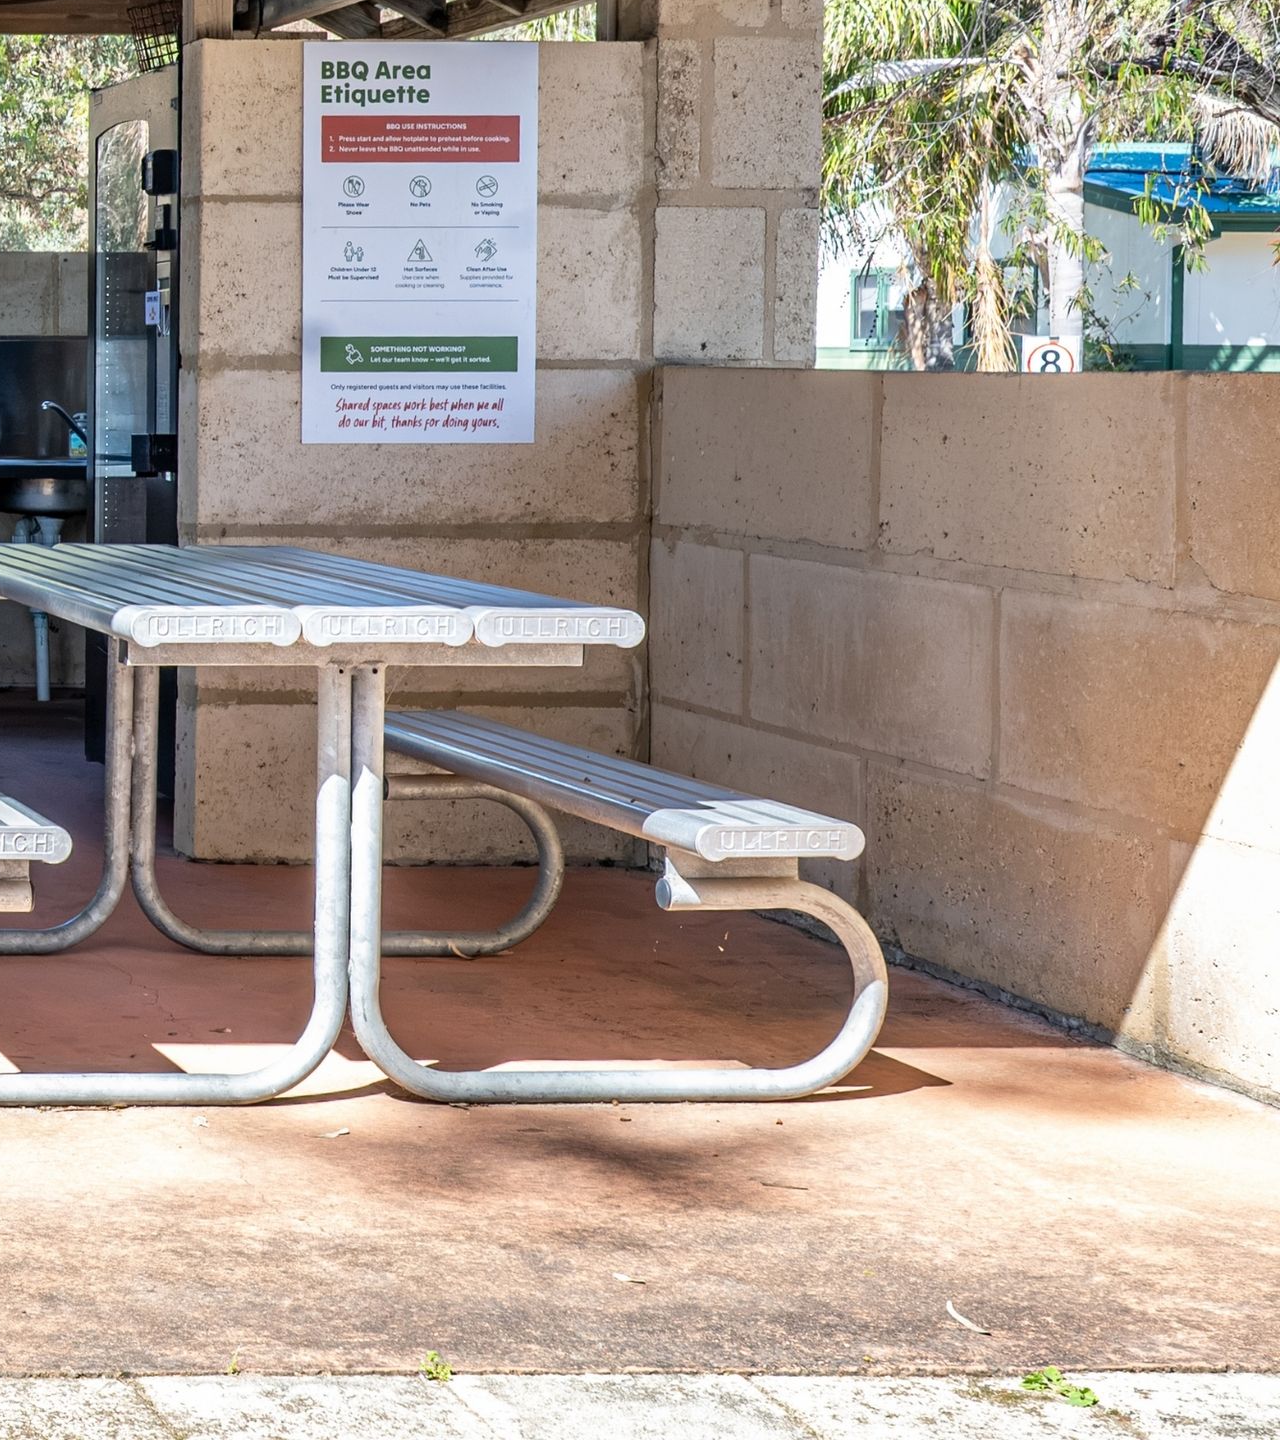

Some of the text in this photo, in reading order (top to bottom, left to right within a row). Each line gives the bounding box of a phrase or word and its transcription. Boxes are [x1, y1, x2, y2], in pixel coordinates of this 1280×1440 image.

[321, 61, 431, 82] BBQ Area
[321, 83, 430, 107] Etiquette
[437, 136, 462, 144] preheat
[484, 136, 511, 144] cooking.
[1040, 349, 1062, 372] 8
[335, 397, 505, 416] Shared spaces work best when we all
[338, 414, 500, 432] do our bit, thanks for doing yours.
[155, 616, 280, 637] ULLRICH
[328, 616, 452, 637] ULLRICH
[500, 617, 623, 638] ULLRICH
[720, 830, 841, 850] ULLRICH
